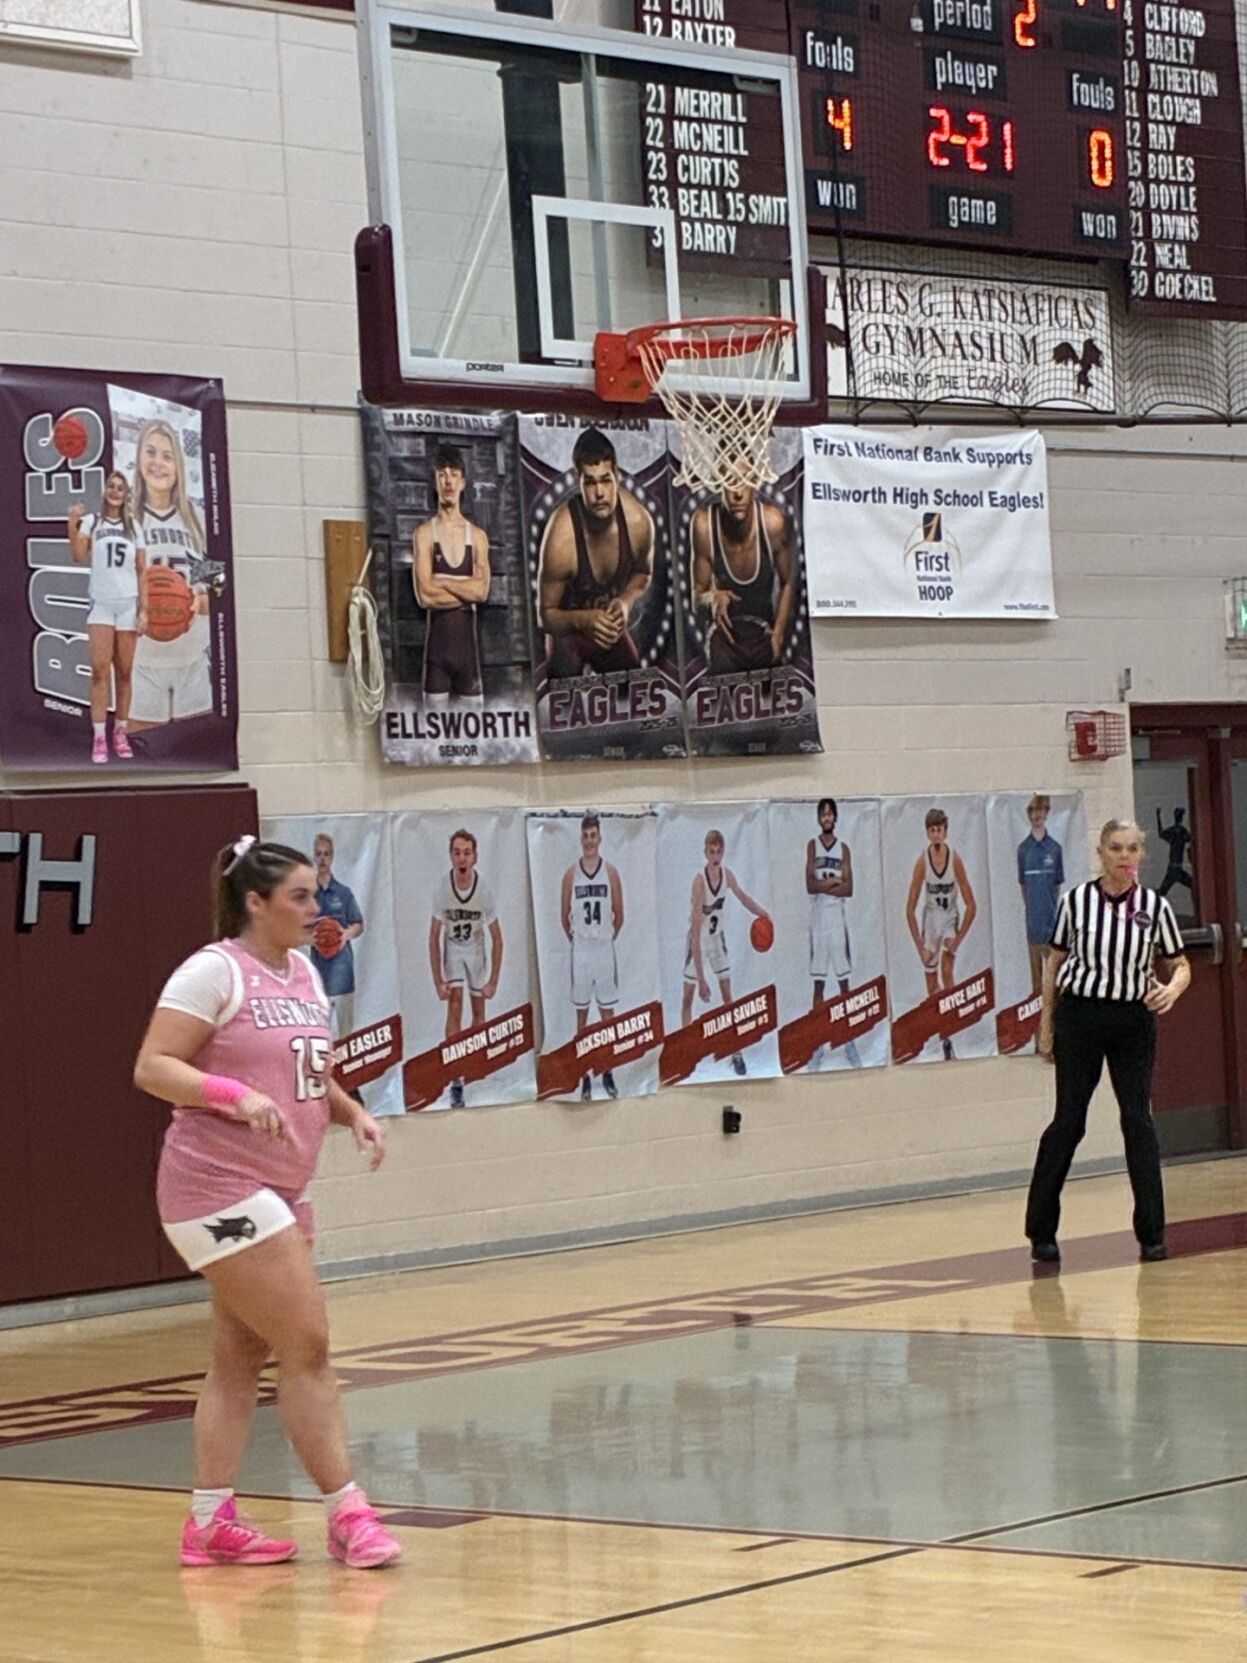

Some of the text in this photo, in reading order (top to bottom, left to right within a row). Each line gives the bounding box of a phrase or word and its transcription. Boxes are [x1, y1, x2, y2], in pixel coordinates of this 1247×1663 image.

[643, 15, 736, 48] 12 BAXTER
[934, 0, 992, 31] period
[1015, 0, 1035, 46] 2
[1144, 3, 1206, 37] CLIFFORD
[806, 31, 854, 72] fouls
[1125, 29, 1134, 57] 5
[935, 51, 998, 93] player
[1123, 59, 1218, 97] 10 ATHERTON
[646, 83, 747, 122] 21 MERRILL
[1072, 73, 1115, 111] fouls
[1124, 89, 1201, 125] 11 CLOUGH
[646, 117, 748, 156] 22 MCNEILL
[827, 97, 852, 150] 4
[1126, 120, 1176, 151] 12 RAY
[648, 152, 739, 188] 23 CURTIS
[1089, 130, 1113, 188] 0
[1127, 149, 1195, 182] 15 BOLES
[649, 186, 787, 226] 33 BEAL 15 SMIT
[948, 194, 997, 227] game
[1128, 181, 1197, 212] 20 DOYLE
[652, 222, 736, 255] 3 BARRY
[1081, 210, 1117, 240] won
[1130, 210, 1143, 237] 21
[1130, 240, 1191, 270] 22 NEAL
[823, 275, 909, 315] ARLES
[1131, 270, 1149, 296] 30
[862, 322, 1039, 366] GYMNASIUM
[873, 368, 1029, 400] HOME OF THE Eagles
[392, 412, 442, 427] MASON
[813, 438, 1033, 468] First National Bank Supports
[811, 482, 1044, 512] Ellsworth High School Eagles!
[107, 543, 127, 568] 15
[915, 551, 950, 572] First
[918, 586, 953, 601] HOOP
[549, 679, 667, 732] EAGLES
[696, 676, 804, 728] EAGLES
[386, 711, 531, 739] ELLSWORTH
[438, 745, 478, 757] SENIOR
[583, 901, 601, 925] 34
[709, 915, 718, 935] 3
[617, 1011, 651, 1037] BARRY
[734, 995, 768, 1023] SAVAGE
[829, 1002, 846, 1023] JOE
[350, 1024, 392, 1052] EASLER
[442, 1014, 524, 1065] DAWSON CURTIS
[289, 1035, 329, 1101] 15
